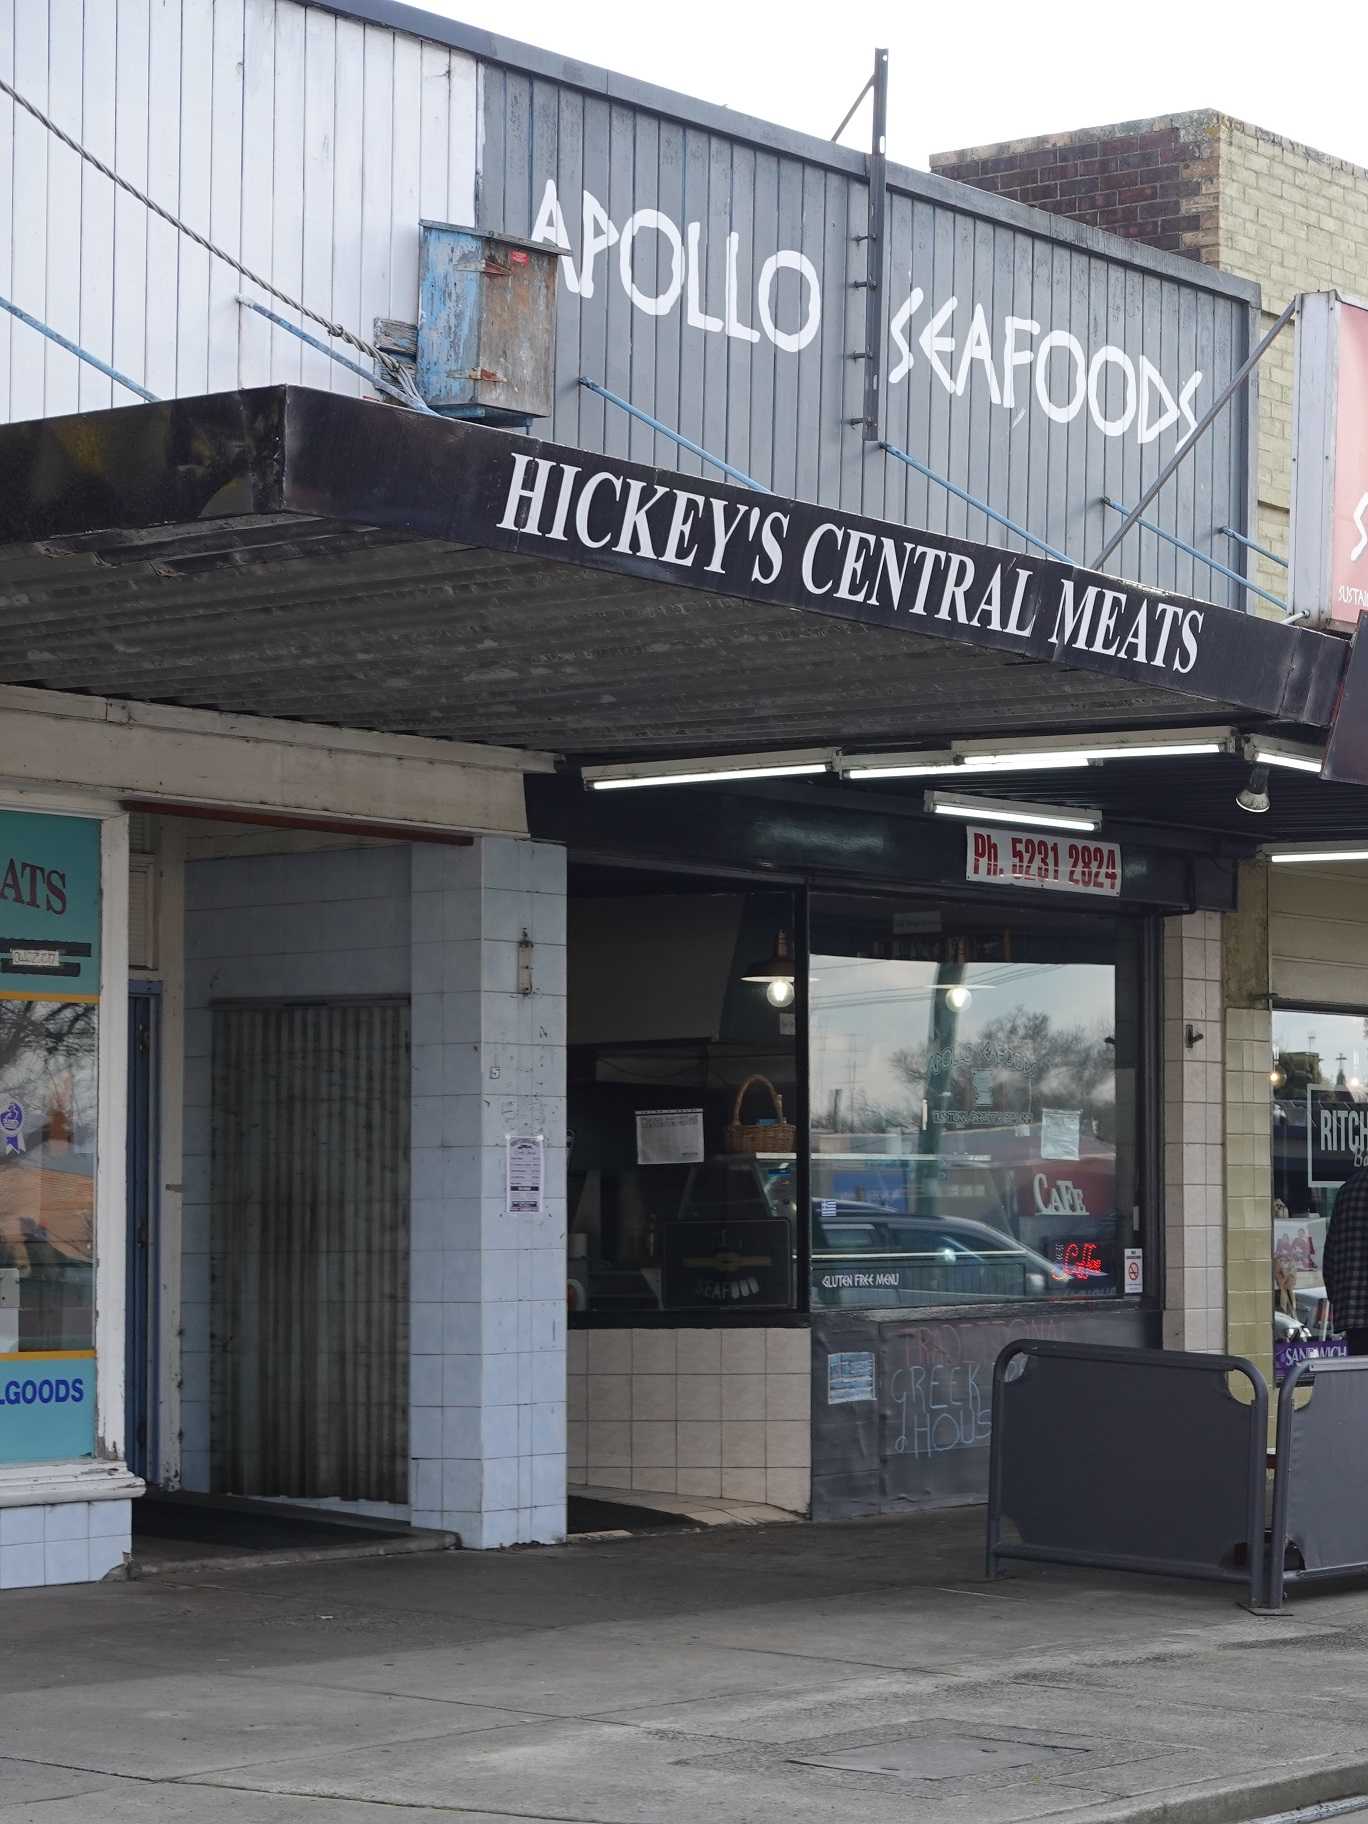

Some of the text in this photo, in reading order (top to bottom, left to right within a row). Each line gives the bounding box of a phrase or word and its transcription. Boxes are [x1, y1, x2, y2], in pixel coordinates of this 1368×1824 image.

[531, 179, 1203, 454] APOLLO SEAFOODS
[496, 453, 1205, 674] HICKEY'S CENTRAL MEATS
[973, 832, 1118, 890] Ph. 5231 2824
[822, 1272, 900, 1289] GLUTEN FREE MENU
